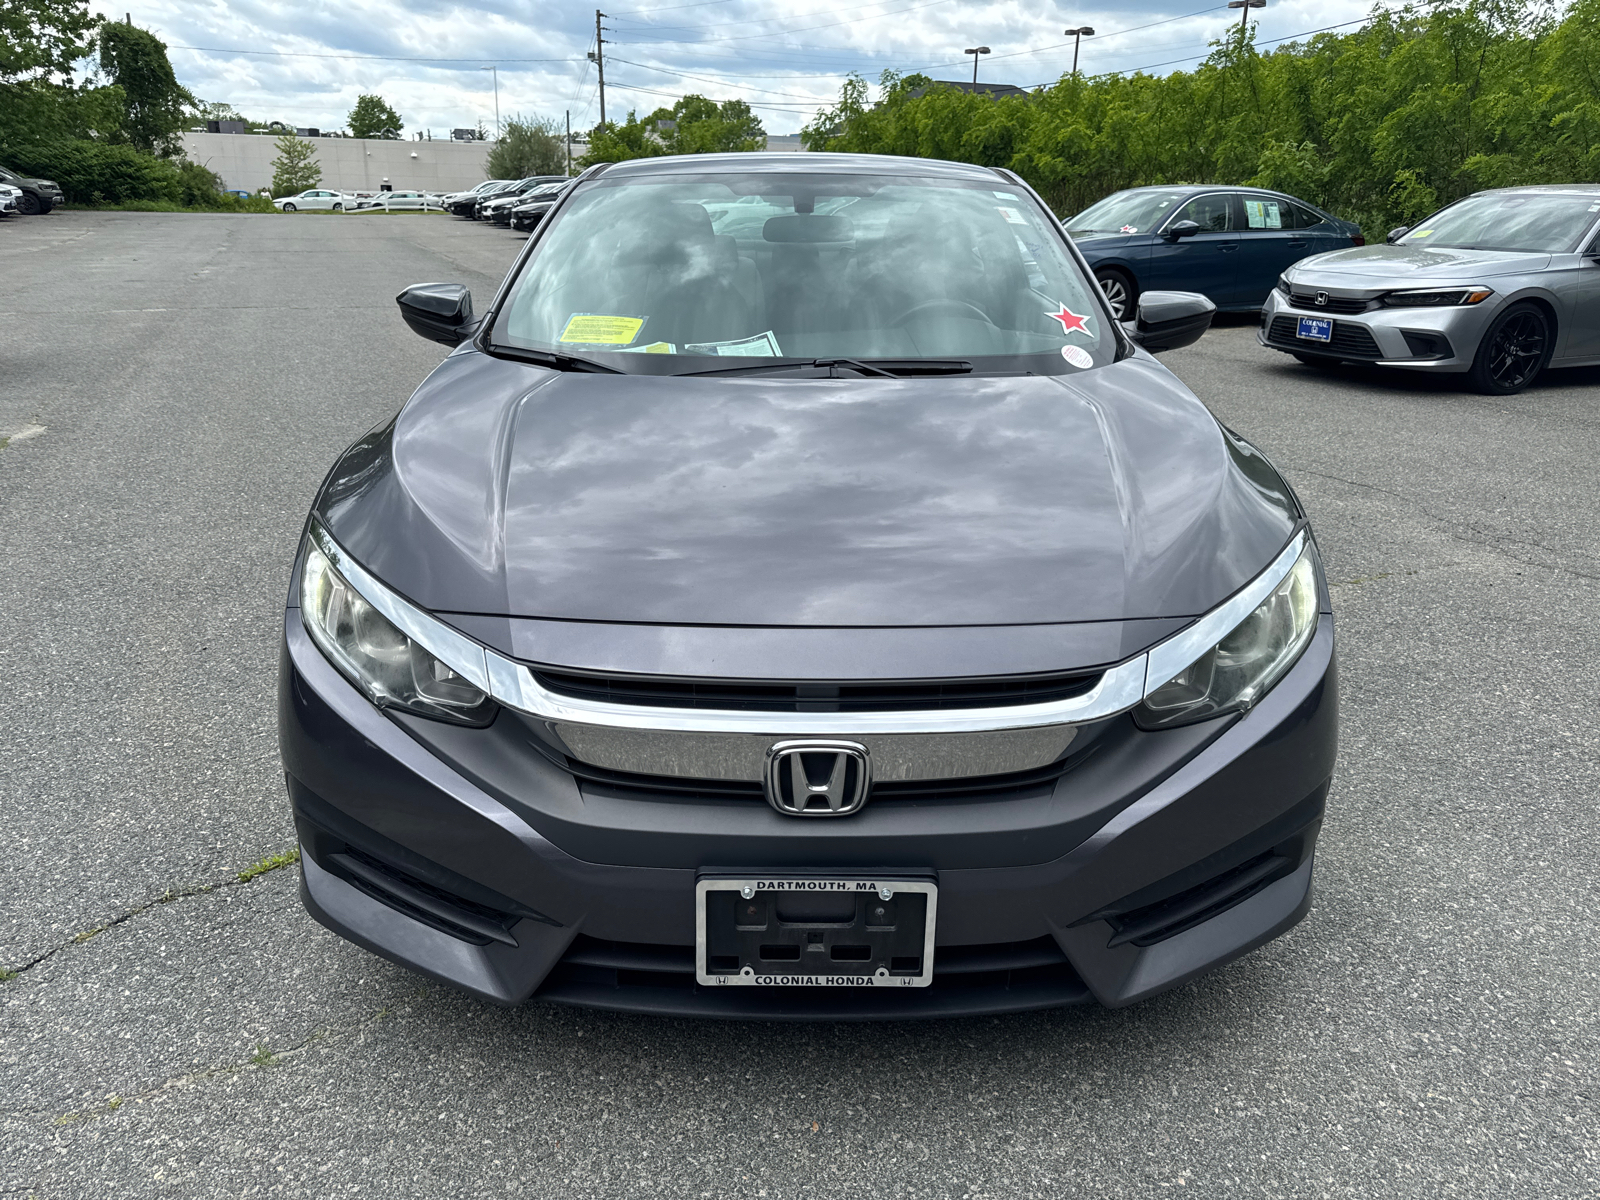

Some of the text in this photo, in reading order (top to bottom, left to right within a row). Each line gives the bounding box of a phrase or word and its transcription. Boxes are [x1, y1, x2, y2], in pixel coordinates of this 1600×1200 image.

[756, 881, 877, 890] DARTMOUTH, MA
[755, 976, 875, 985] COLONIAL HONDA
